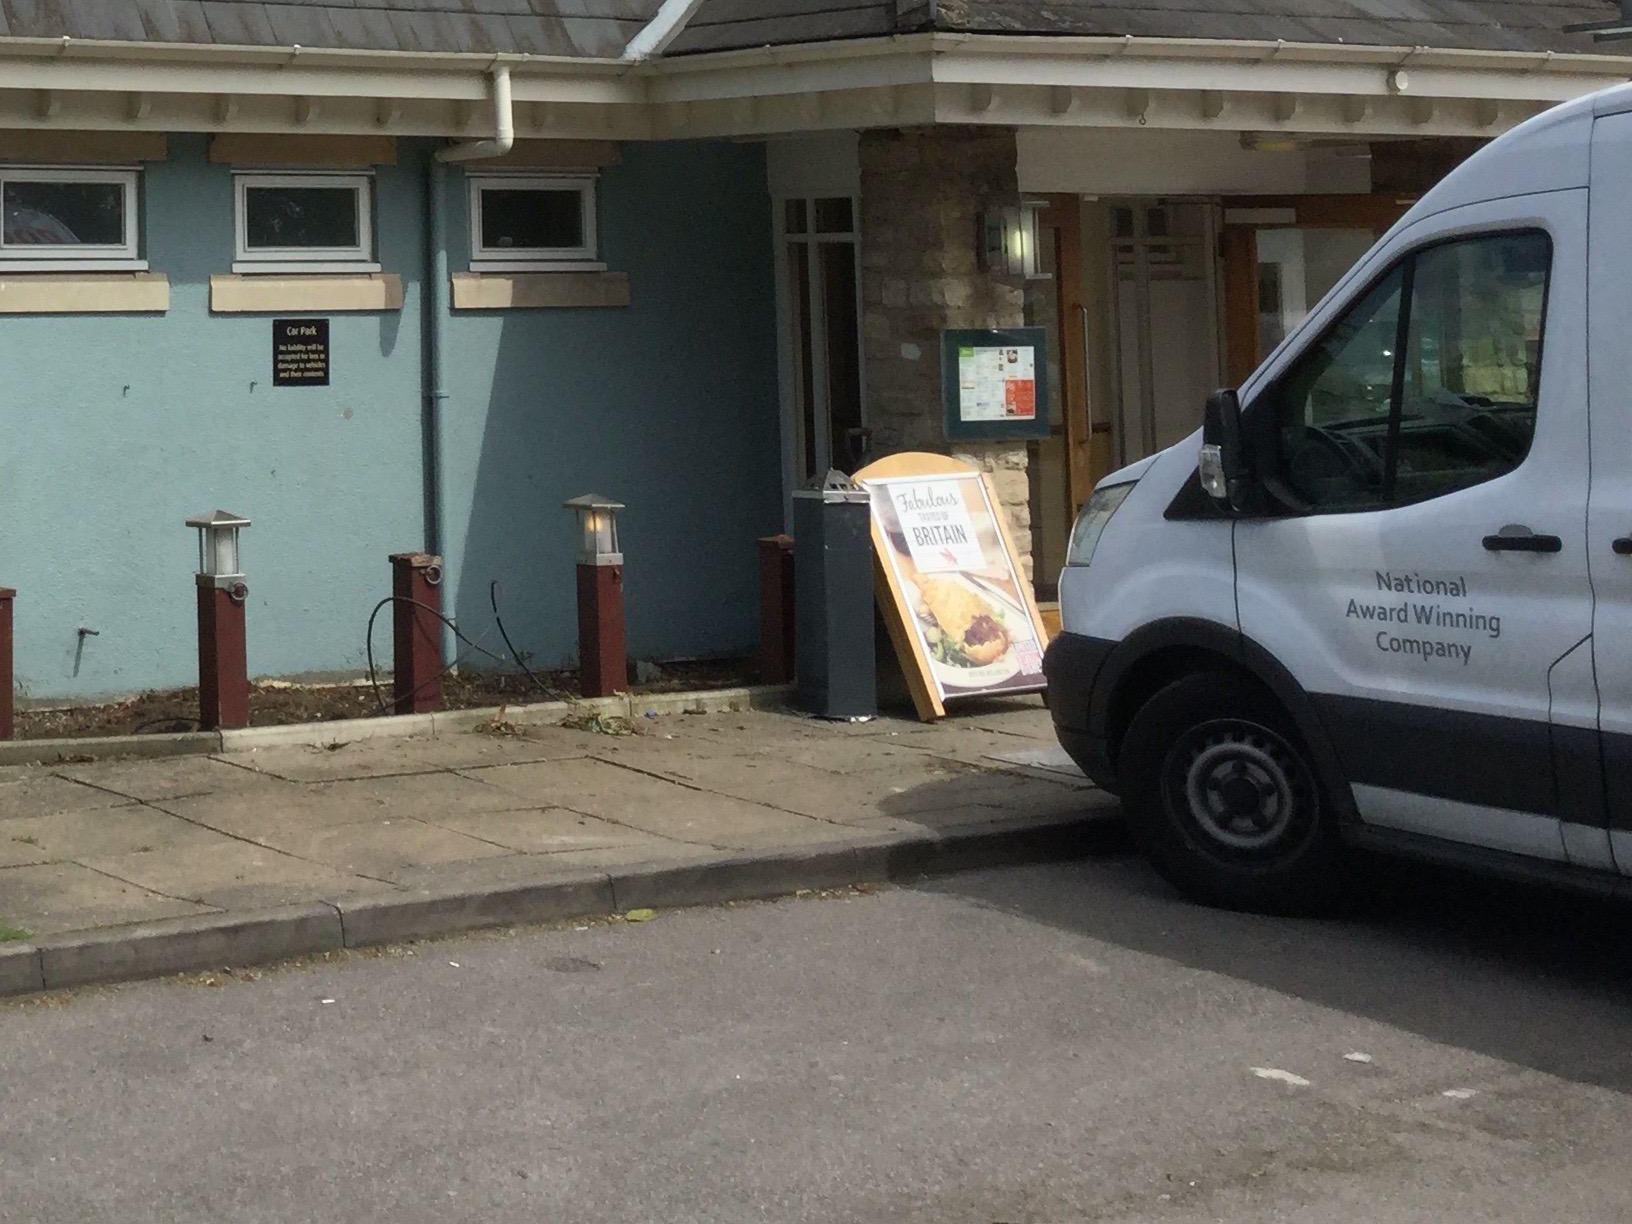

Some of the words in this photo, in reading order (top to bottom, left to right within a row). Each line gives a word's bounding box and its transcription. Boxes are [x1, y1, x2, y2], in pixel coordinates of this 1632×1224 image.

[287, 326, 299, 336] Car
[300, 326, 317, 336] Park
[897, 487, 958, 513] Fabulous
[912, 525, 968, 547] BRITAIN
[1375, 570, 1467, 597] National
[1346, 599, 1408, 623] Award
[1413, 603, 1501, 638] Winning
[1375, 631, 1471, 666] Company
